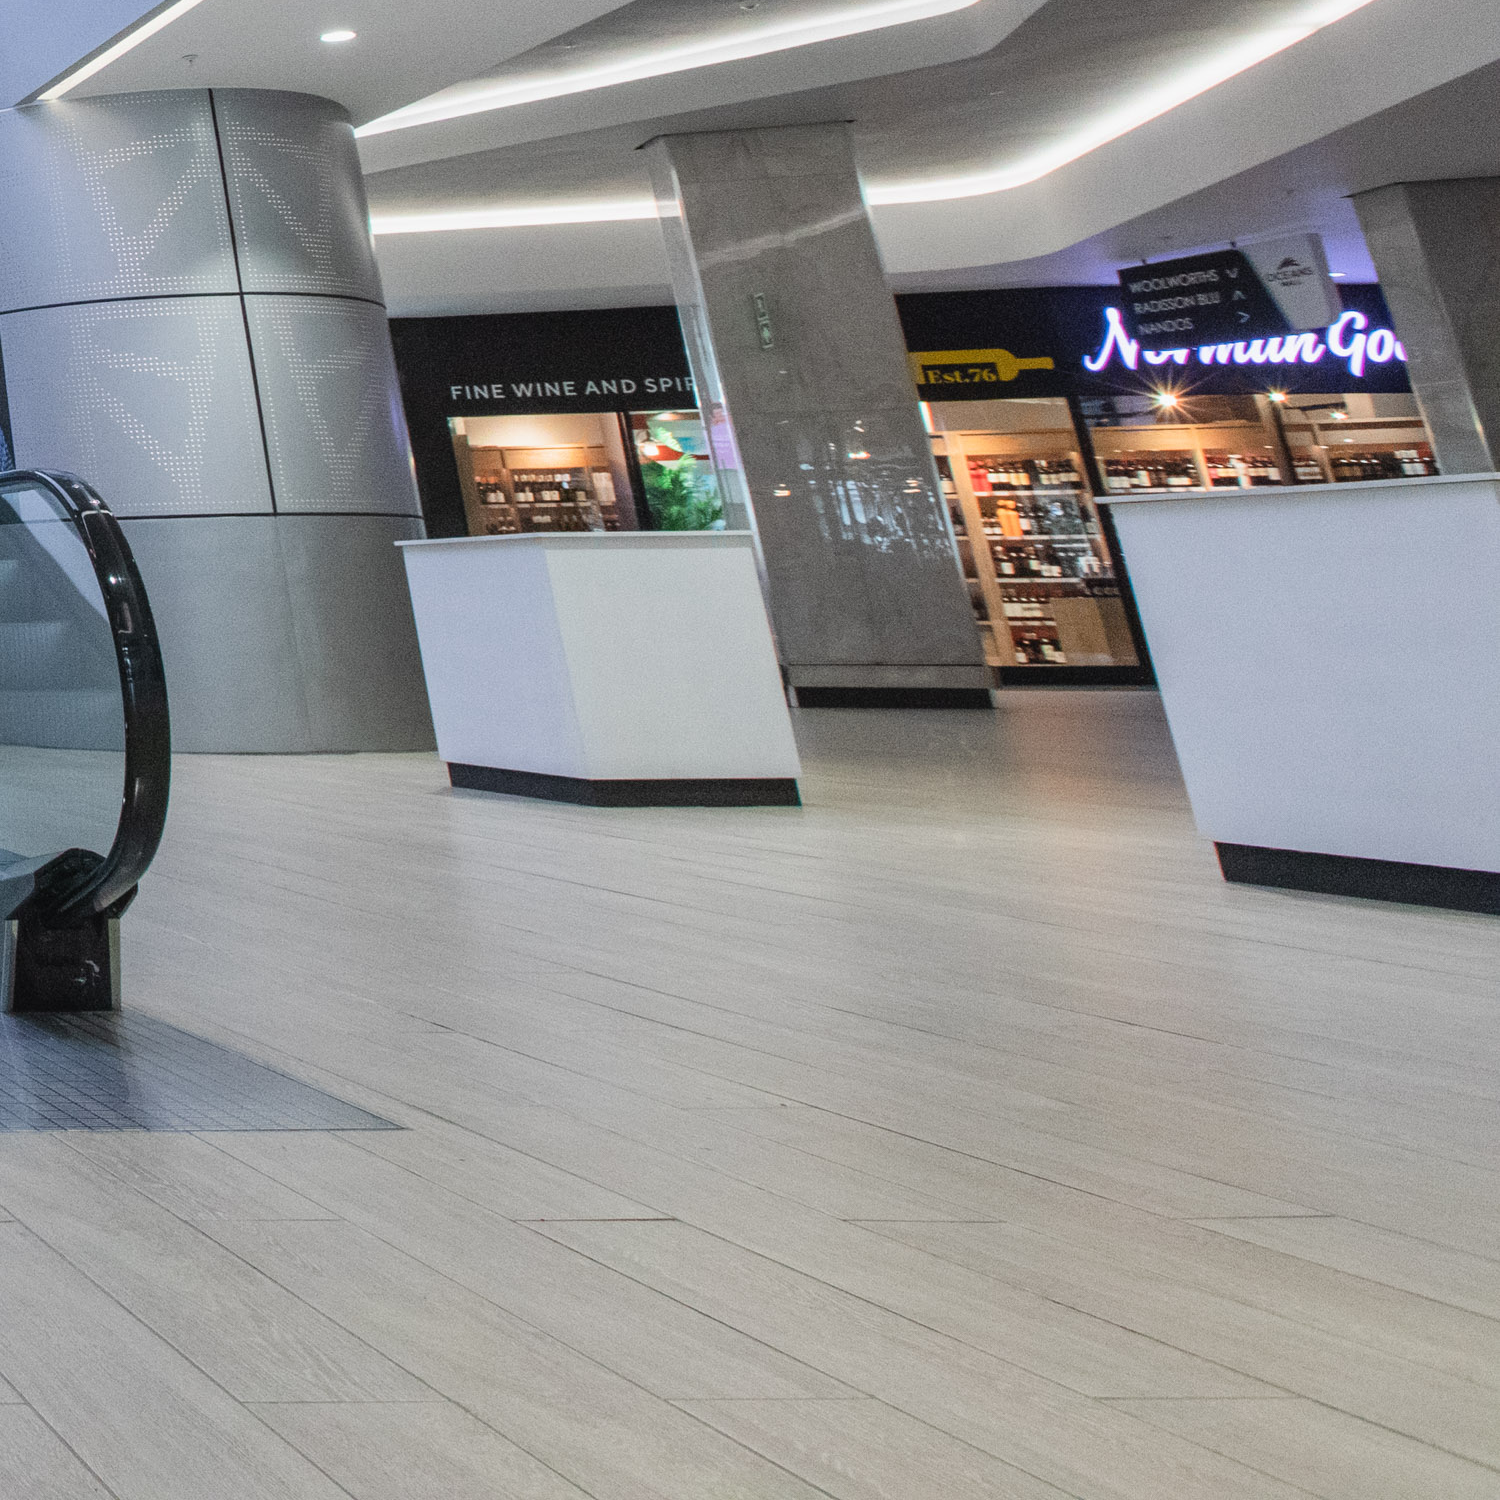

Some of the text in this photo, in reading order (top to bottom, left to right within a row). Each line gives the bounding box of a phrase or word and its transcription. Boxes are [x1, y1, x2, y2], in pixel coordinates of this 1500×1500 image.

[1129, 269, 1219, 293] WOOLWORTHS
[1133, 296, 1196, 314] RADISSON
[1138, 317, 1194, 335] NANDOS
[926, 368, 997, 384] Est.76
[450, 384, 506, 400] FINE
[511, 380, 578, 398] WINE
[585, 378, 638, 396] AND
